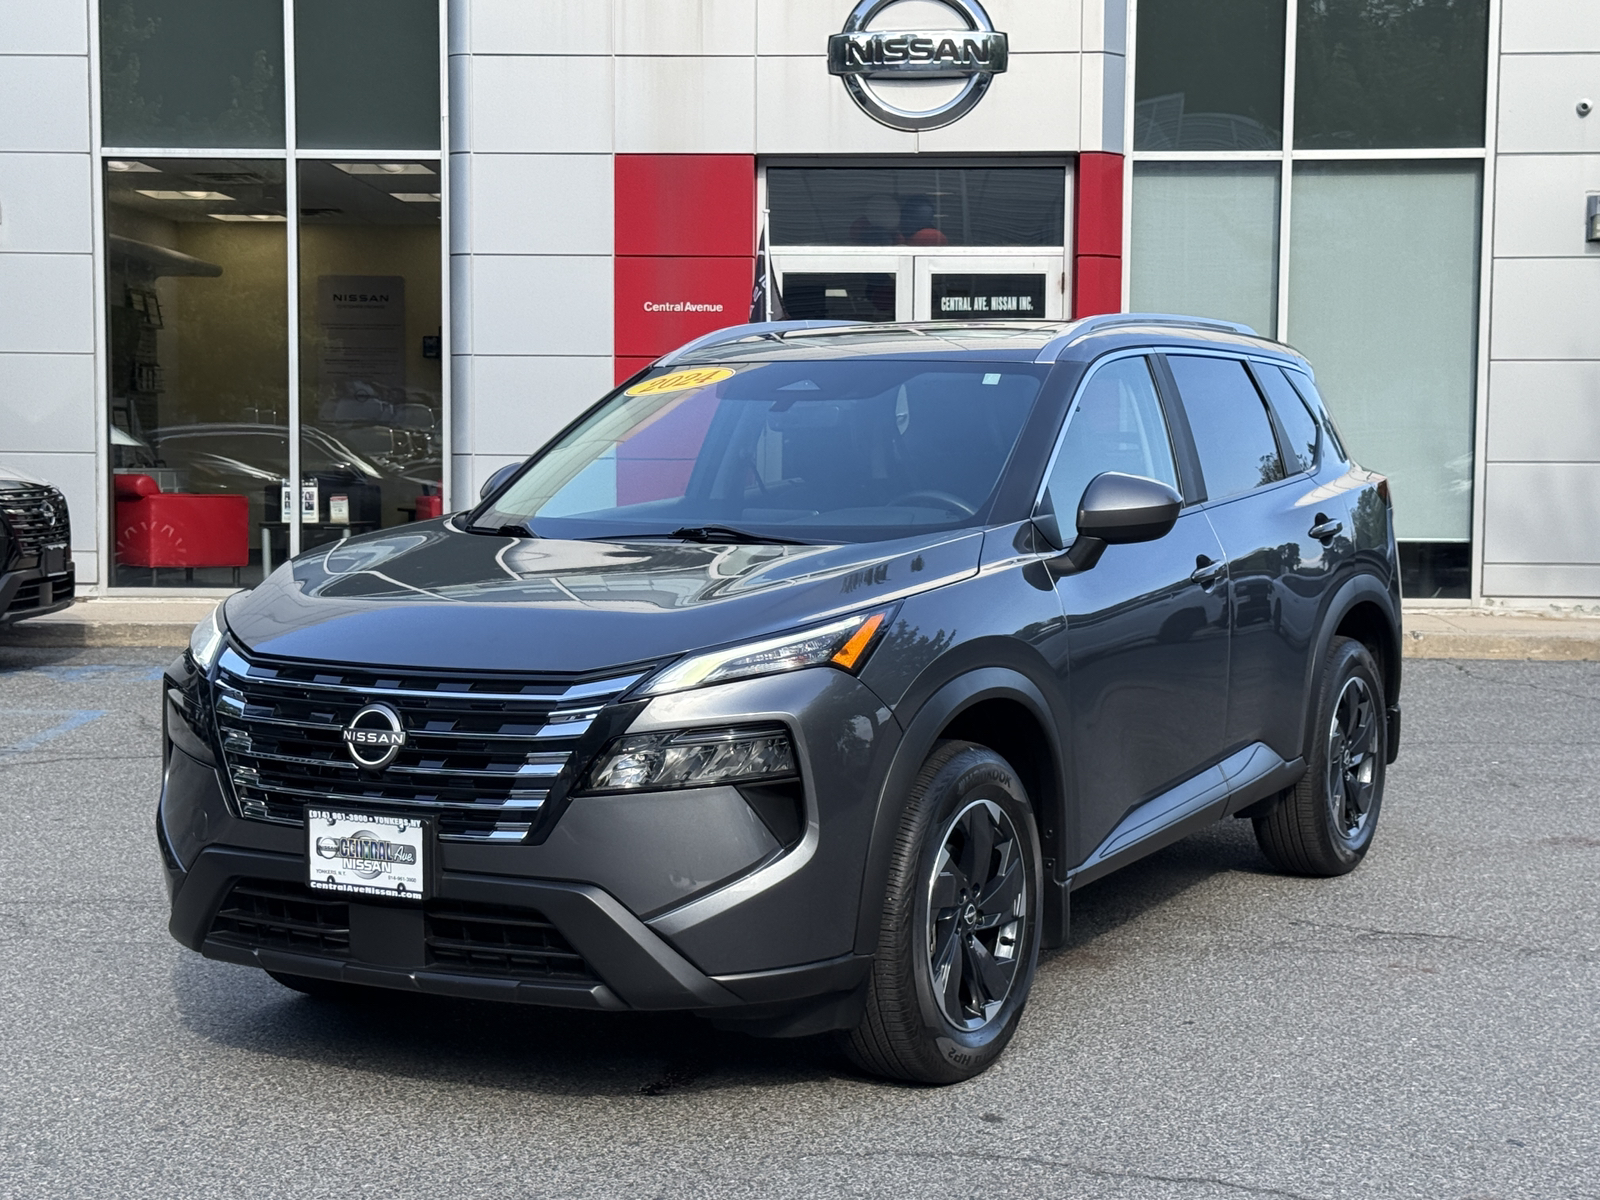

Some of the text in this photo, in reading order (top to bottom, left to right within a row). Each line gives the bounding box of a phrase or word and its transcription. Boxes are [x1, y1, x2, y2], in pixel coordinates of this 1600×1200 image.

[845, 38, 990, 65] NISSAN
[333, 294, 389, 302] NISSAN
[941, 296, 1034, 311] CENTRAL AVE. NISSAN INC.
[643, 301, 724, 312] Central Avenue
[638, 370, 721, 393] 2024
[343, 730, 404, 744] NISSAN
[340, 837, 414, 862] CENTRAL Ave.
[342, 858, 392, 873] NISSAN
[310, 882, 422, 899] CentralAveNissan.com
[948, 1047, 972, 1066] HP2
